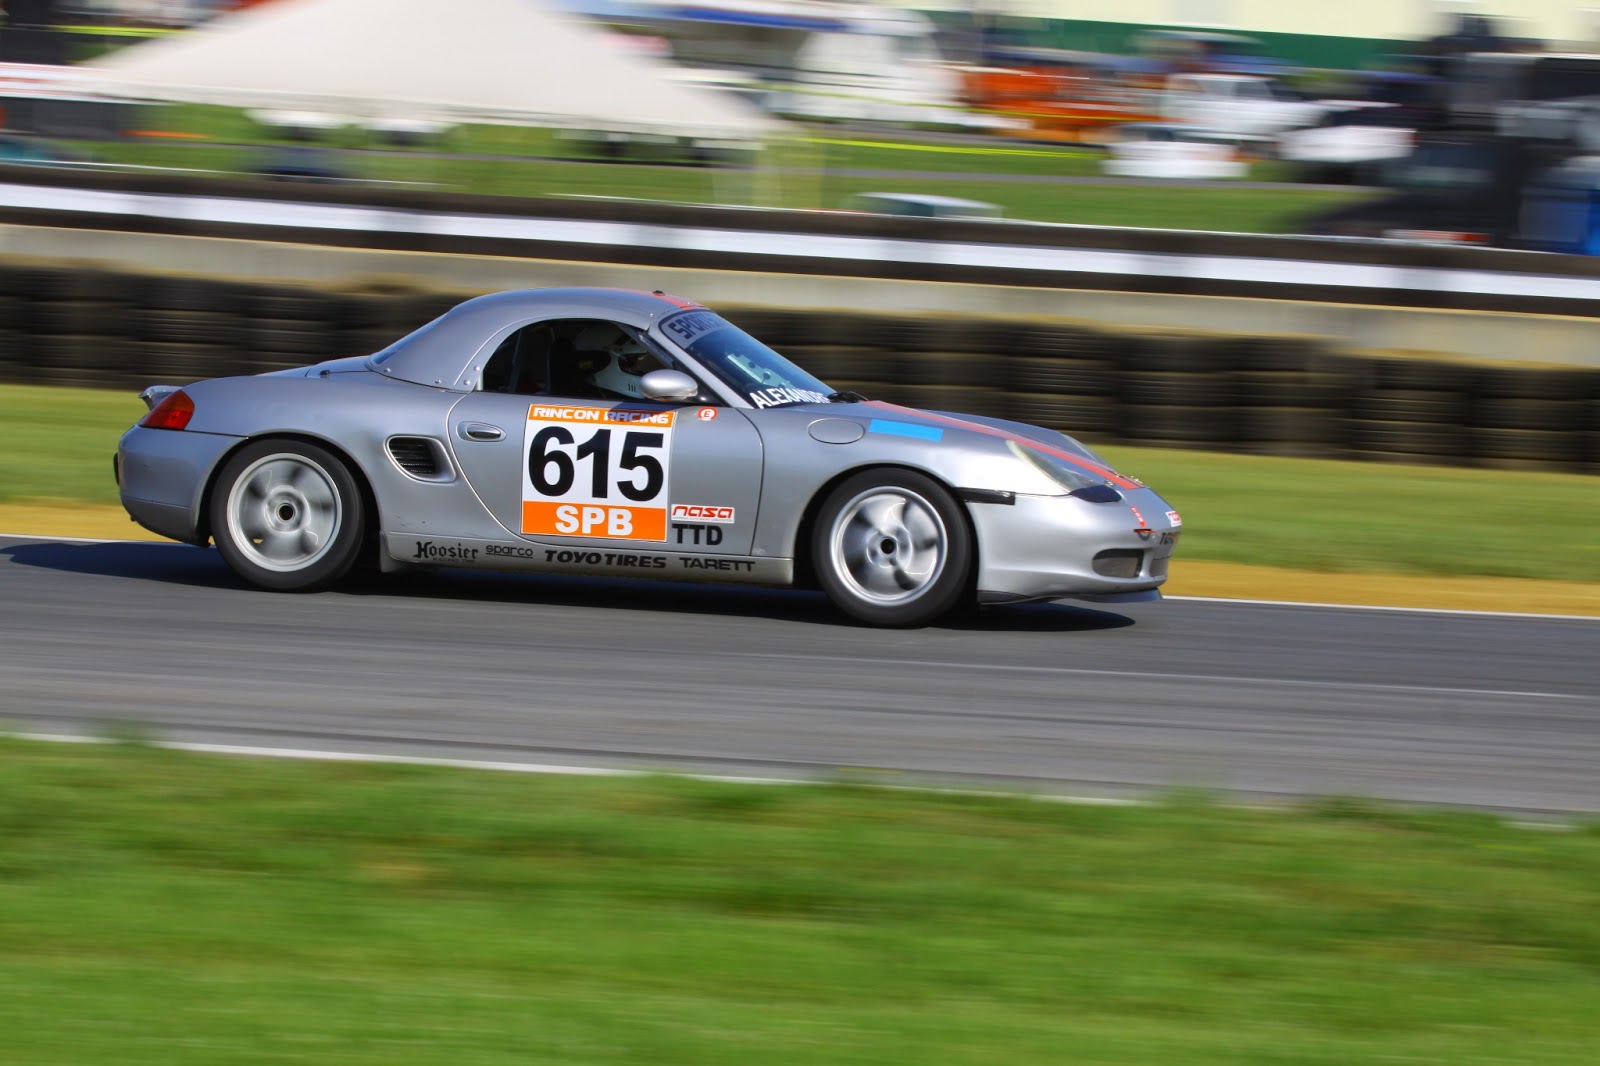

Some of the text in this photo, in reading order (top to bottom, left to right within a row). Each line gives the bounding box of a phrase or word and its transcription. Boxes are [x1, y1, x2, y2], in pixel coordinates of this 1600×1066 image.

[533, 407, 669, 424] RINCON RACING
[528, 426, 664, 502] 615
[555, 505, 633, 536] SPB
[673, 506, 733, 519] nasa
[672, 524, 723, 546] TTD
[413, 541, 479, 559] Hoosier
[486, 544, 533, 558] sparco
[545, 550, 667, 569] TOYO TIRES
[679, 557, 755, 572] TARETT
